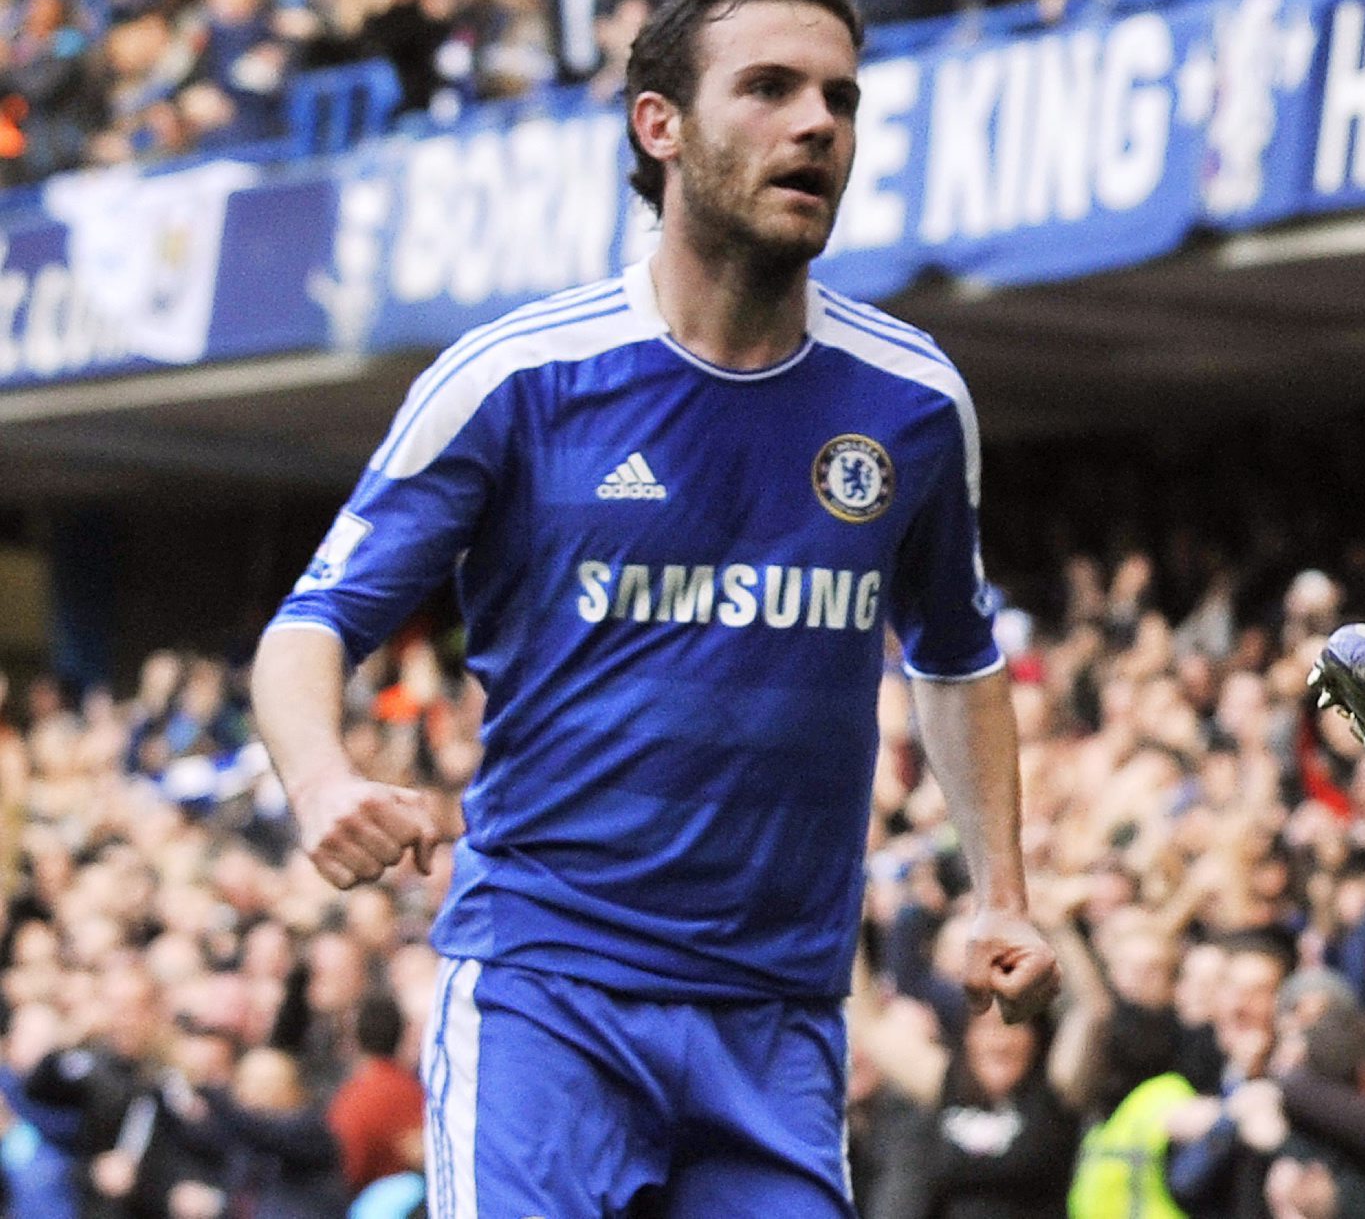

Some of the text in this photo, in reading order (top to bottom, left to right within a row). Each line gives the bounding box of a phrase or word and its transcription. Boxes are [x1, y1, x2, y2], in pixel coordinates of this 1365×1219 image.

[919, 10, 1174, 244] KING
[596, 481, 667, 501] adidas
[577, 560, 882, 631] SAMSUNG
